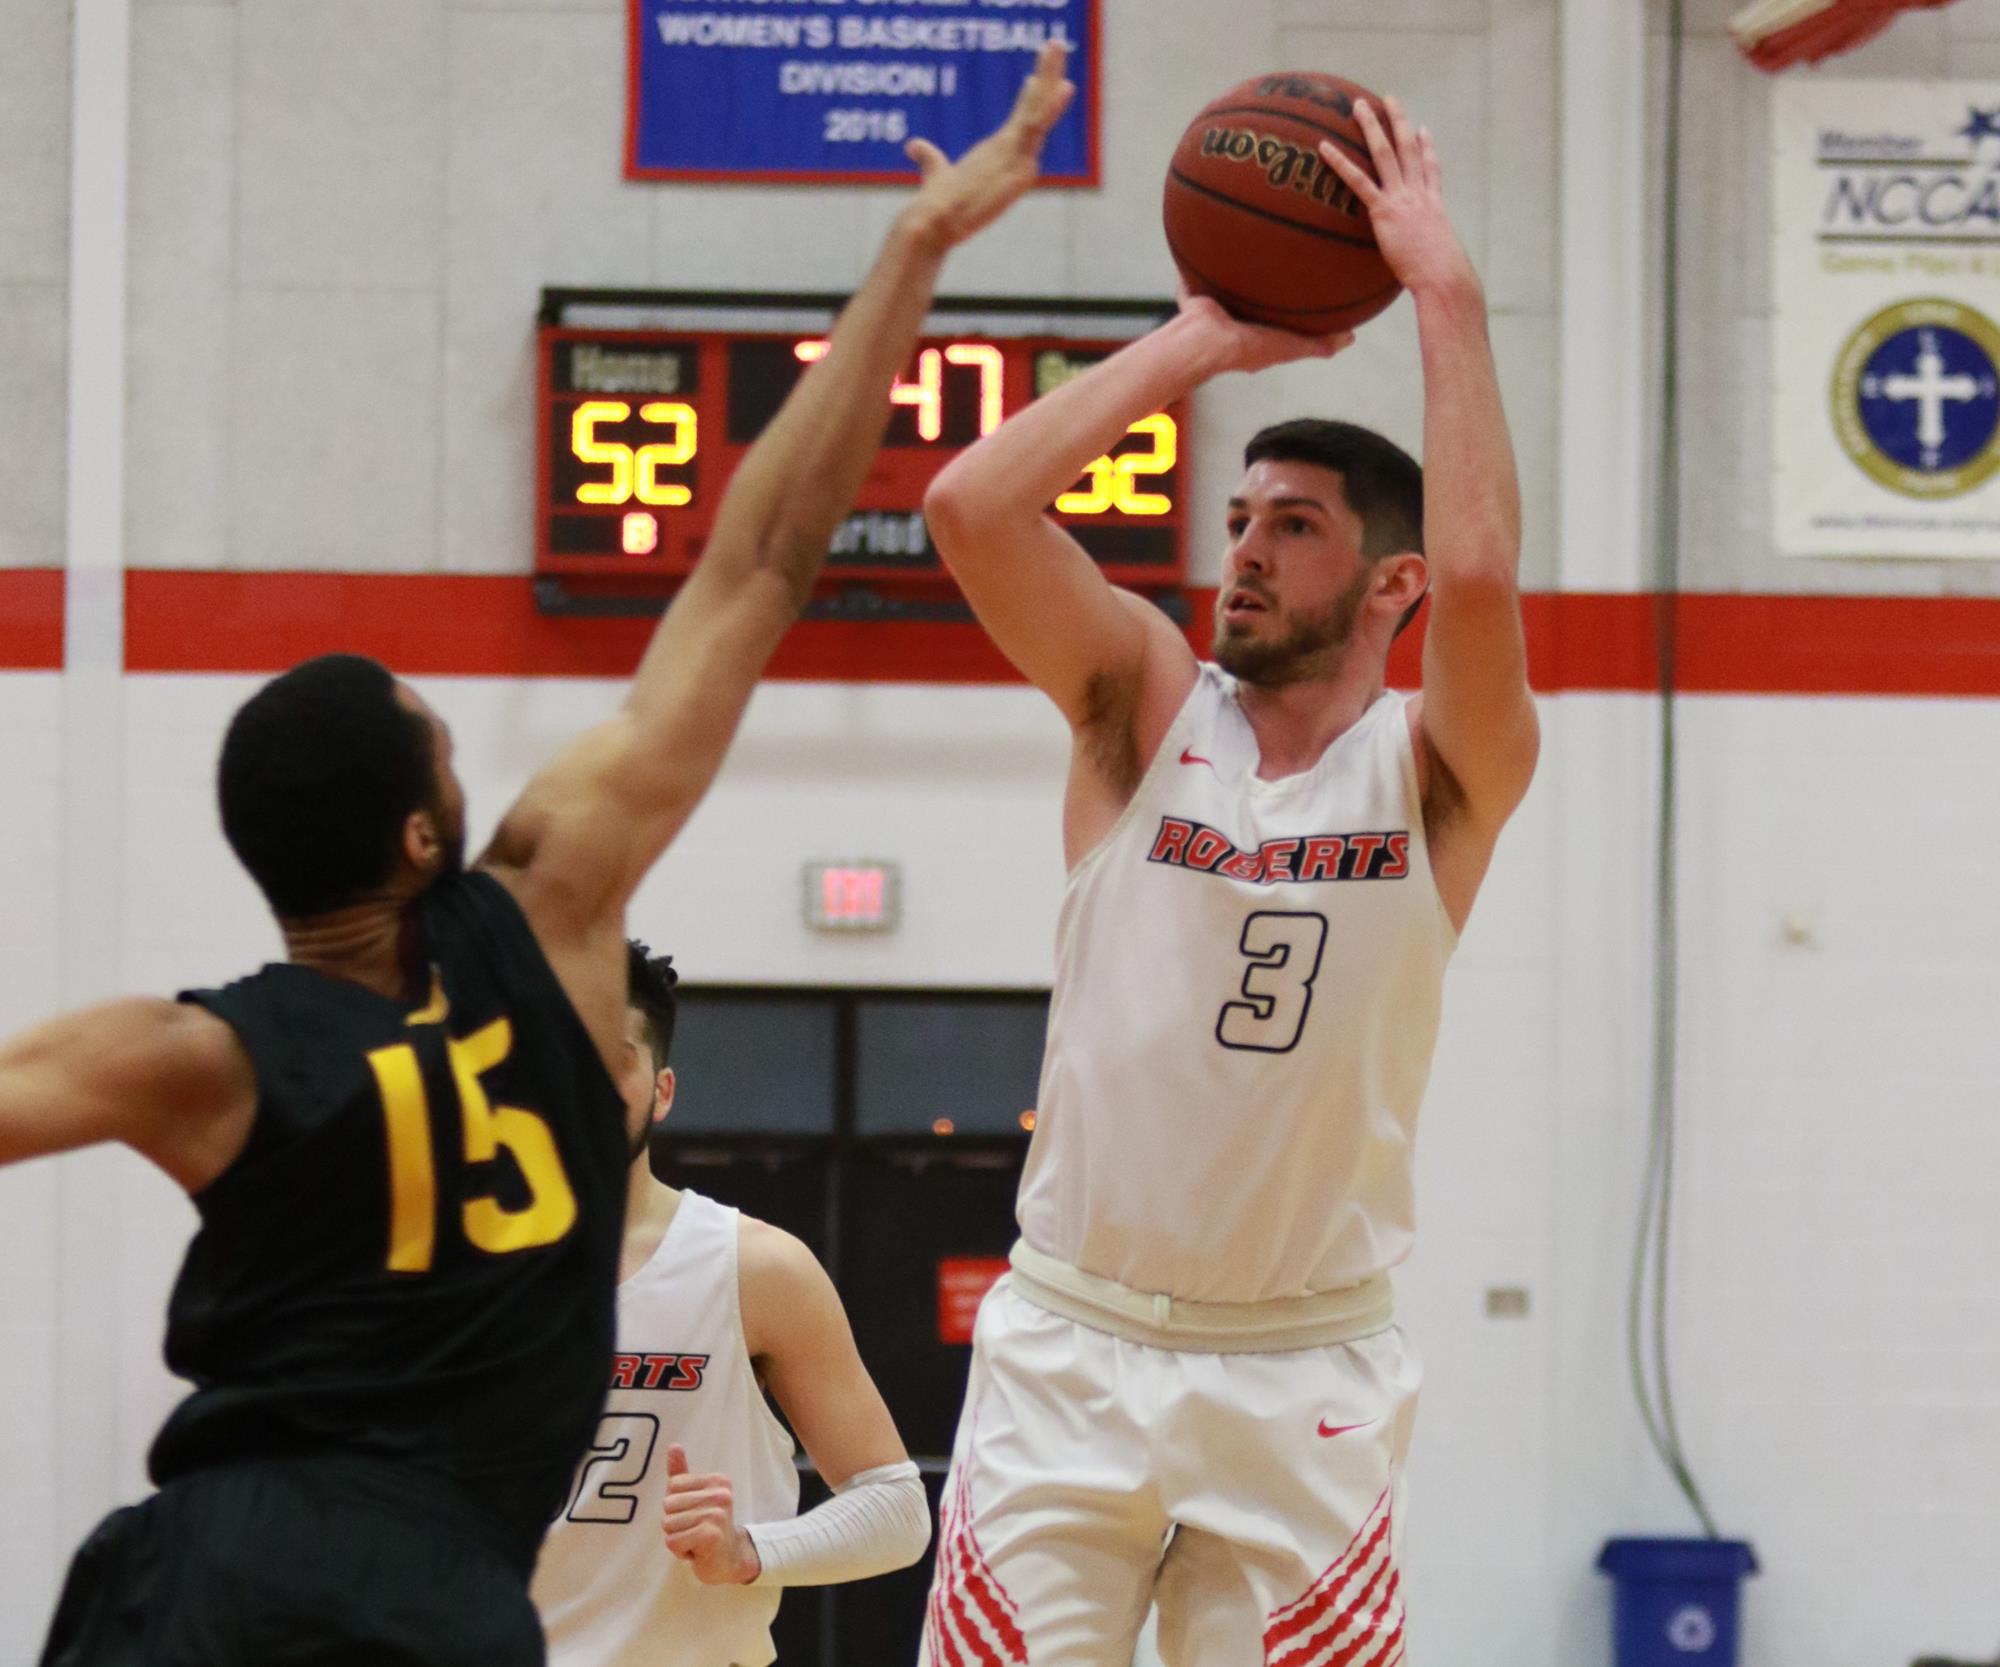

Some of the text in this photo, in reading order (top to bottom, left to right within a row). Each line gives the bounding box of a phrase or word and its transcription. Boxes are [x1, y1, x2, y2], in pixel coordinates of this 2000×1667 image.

[655, 12, 1076, 53] WOMEN'S BASKETBALL
[779, 60, 957, 97] DIVISION I
[571, 346, 679, 390] Home
[571, 401, 698, 505] 52
[1147, 816, 1410, 885] ROBERTS
[1215, 911, 1328, 1054] 3
[366, 1015, 578, 1272] 15
